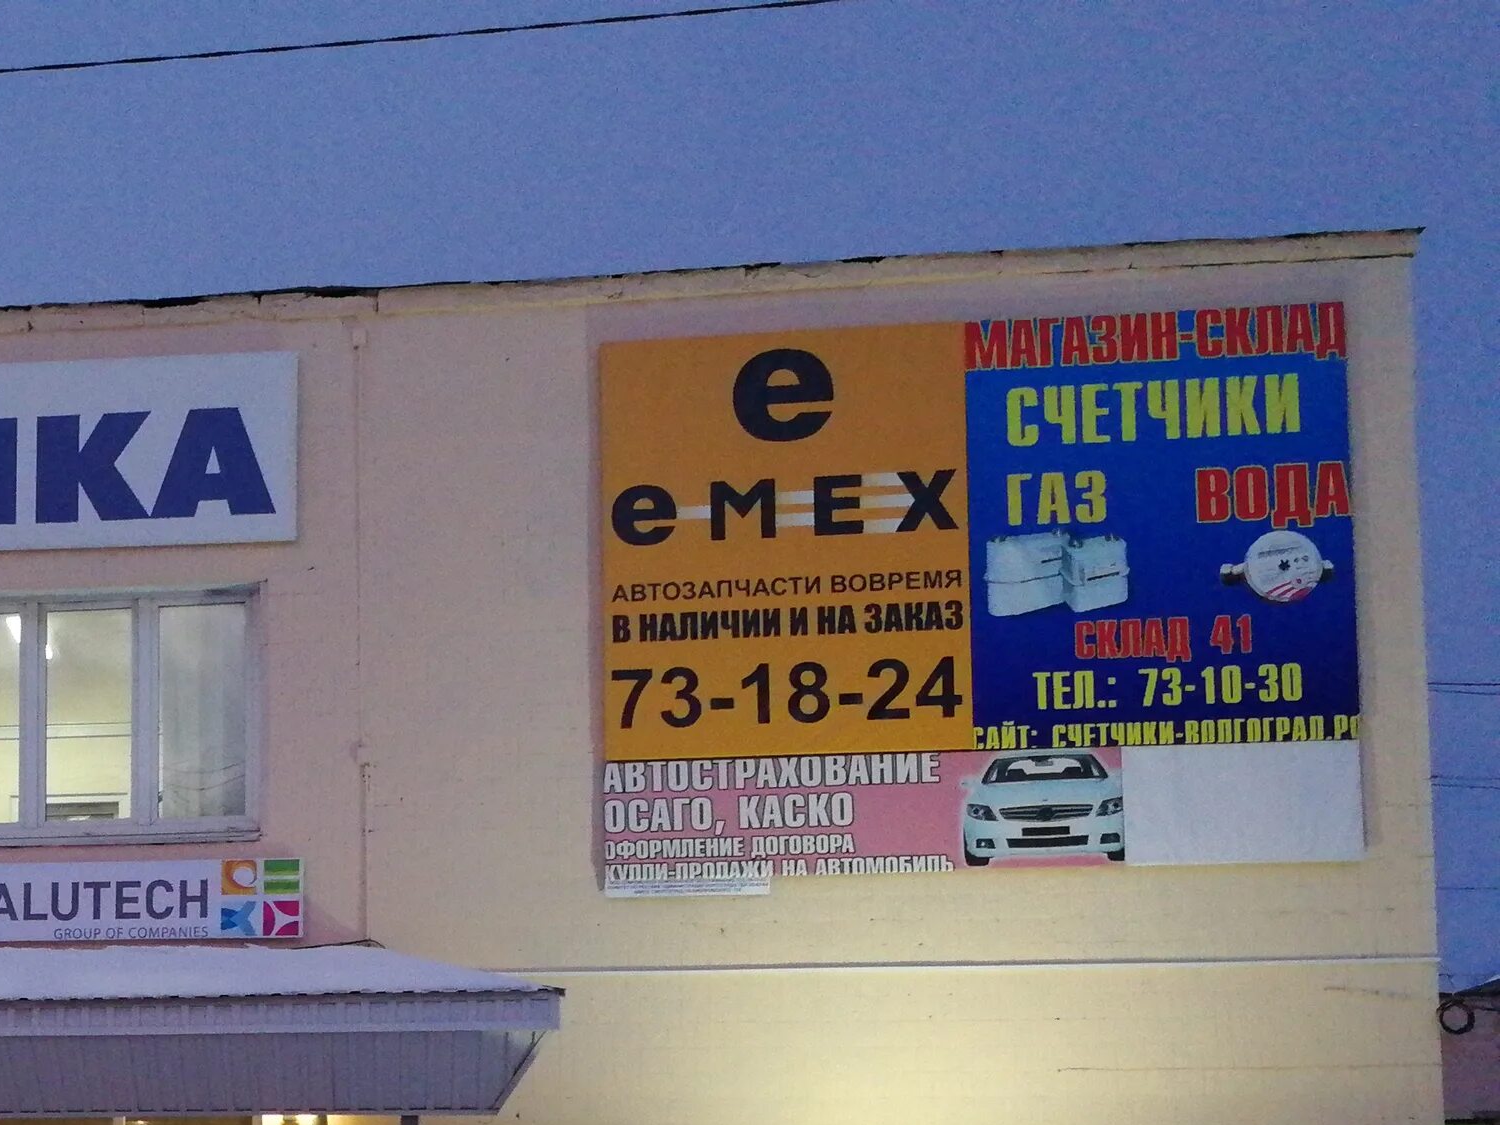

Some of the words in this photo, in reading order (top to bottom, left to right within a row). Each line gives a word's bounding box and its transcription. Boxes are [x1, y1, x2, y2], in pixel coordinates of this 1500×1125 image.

[965, 302, 1347, 371] МАГАЗИН-СКЛАД
[1006, 373, 1301, 447] СЧЕТЧИКИ
[1007, 470, 1107, 527] ГАЗ
[1196, 461, 1352, 529] ВОДА
[612, 576, 822, 602] АВТОЗАПЧАСТИ
[831, 569, 963, 594] ВОВРЕМЯ
[612, 614, 631, 643] В
[639, 607, 782, 642] НАЛИЧИИ
[789, 607, 809, 637] И
[817, 605, 858, 635] НА
[864, 599, 964, 632] ЗАКАЗ
[1075, 616, 1192, 662] СКЛАД
[1209, 614, 1253, 654] 41
[611, 656, 963, 729] 73-18-24
[1032, 669, 1117, 711] ТЕЛ.:
[1137, 662, 1304, 707] 73-10-30
[603, 752, 941, 794] АВТОСТРАХОВАНИЕ
[604, 797, 725, 836] ОСАГО,
[738, 791, 854, 829] КАСКО
[605, 836, 745, 860] ОФОРМЛЕНИЕ
[750, 833, 855, 860] ДОГОВОРА
[781, 858, 808, 877] НА
[54, 928, 101, 940] GROUP
[106, 927, 124, 939] OF
[128, 926, 209, 939] COMPANIES
